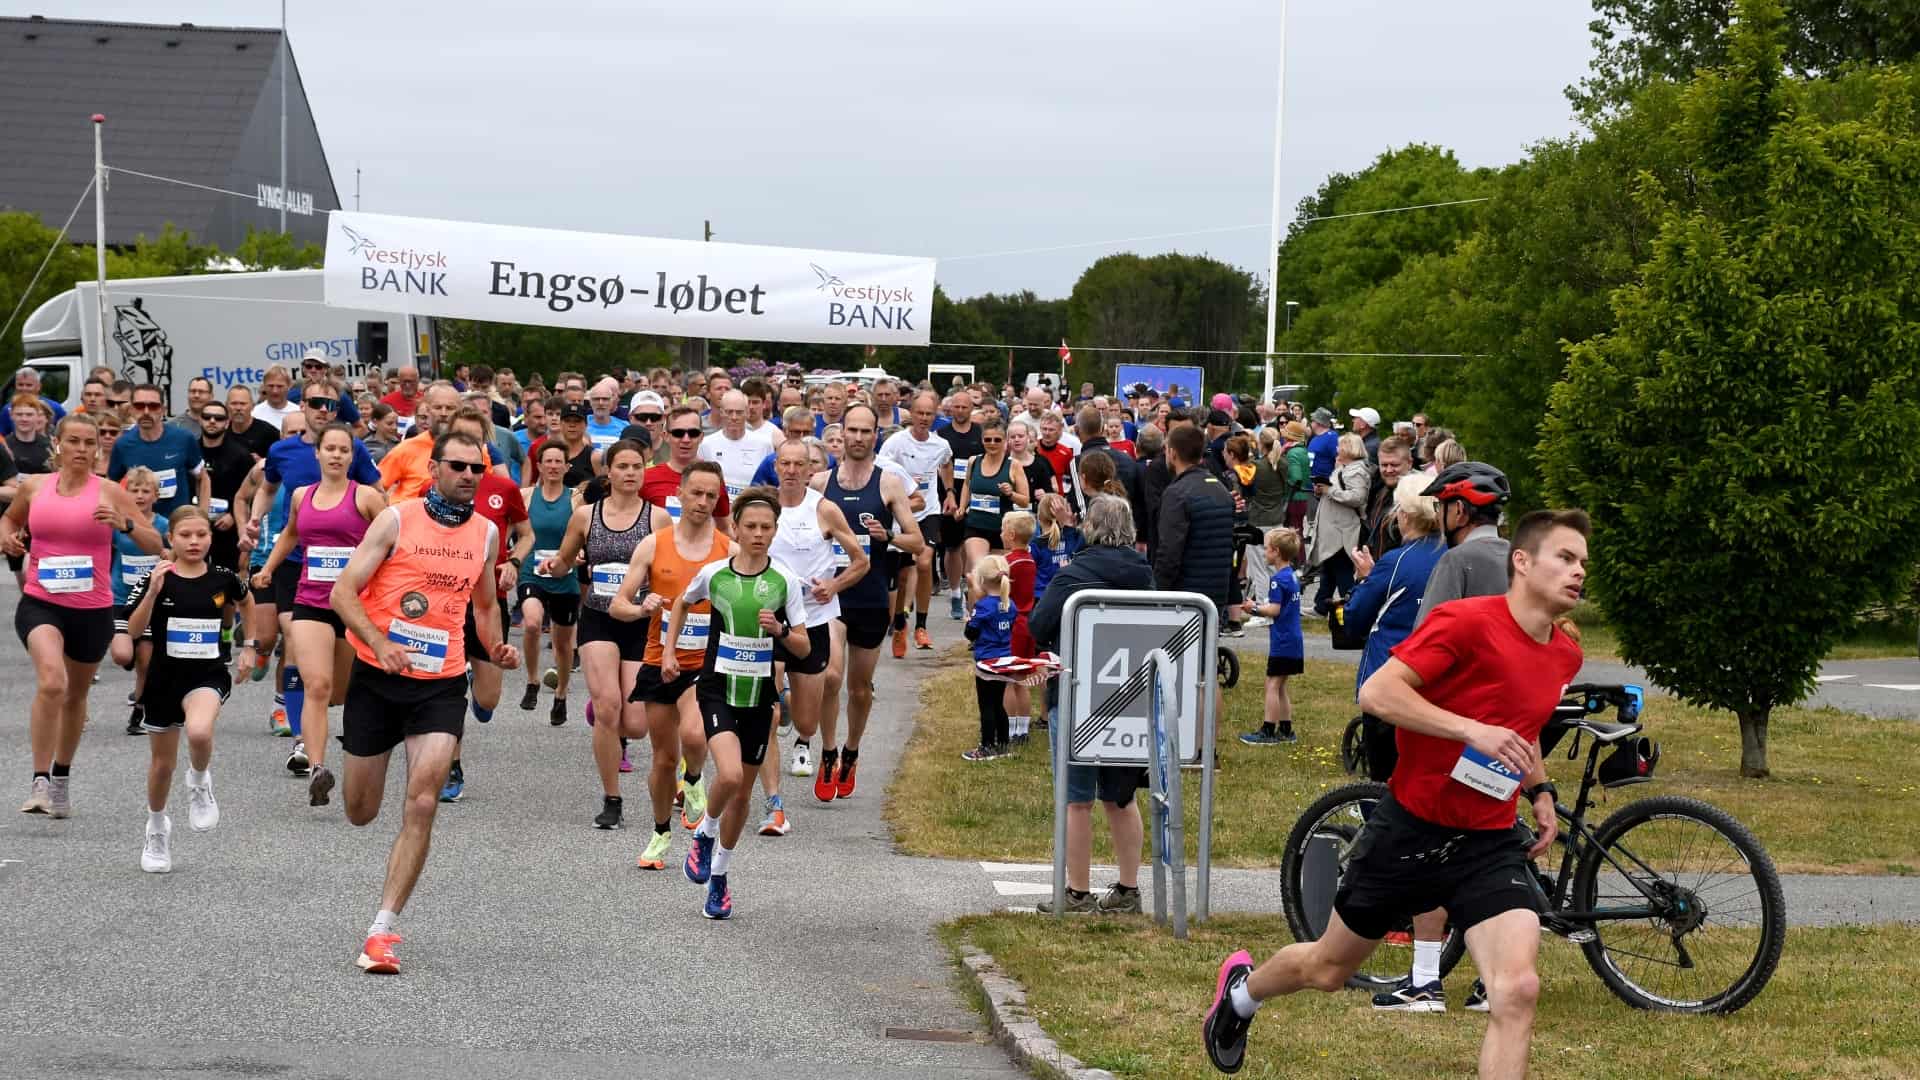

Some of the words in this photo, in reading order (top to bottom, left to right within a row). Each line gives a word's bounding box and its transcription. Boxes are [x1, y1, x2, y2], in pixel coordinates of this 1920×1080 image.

[364, 247, 447, 270] vestjysk
[361, 266, 448, 297] BANK
[488, 260, 766, 315] Engsø-løbet
[832, 285, 912, 305] vestjysk
[829, 302, 914, 331] BANK
[265, 339, 359, 361] GRINDST
[414, 545, 473, 560] JesusNet.dk
[321, 559, 339, 568] 350
[55, 569, 76, 578] 393
[608, 574, 624, 584] 351
[188, 632, 202, 643] 28
[736, 651, 756, 661] 296
